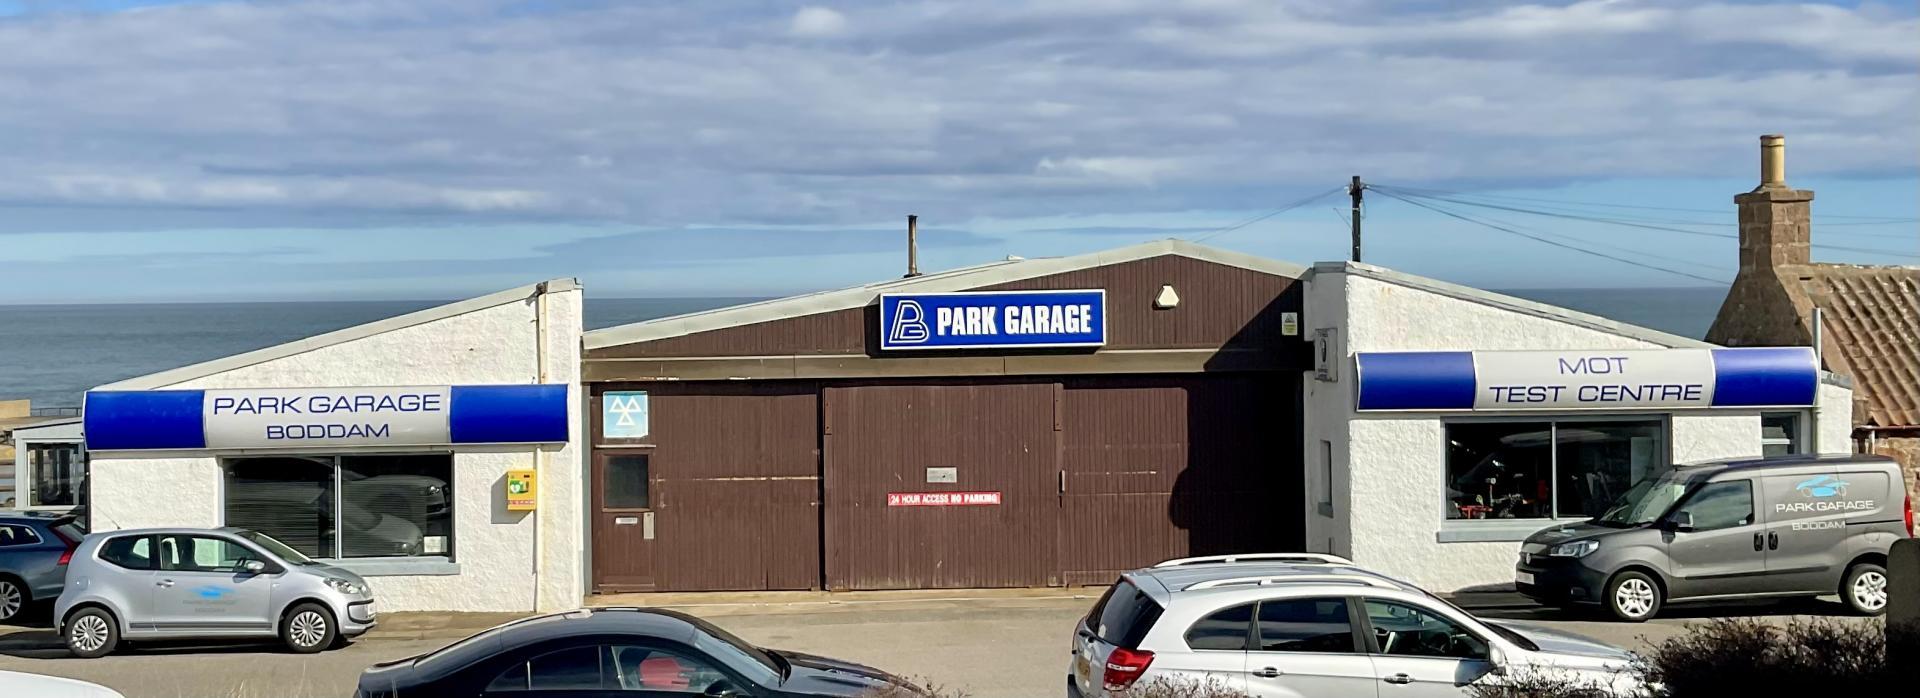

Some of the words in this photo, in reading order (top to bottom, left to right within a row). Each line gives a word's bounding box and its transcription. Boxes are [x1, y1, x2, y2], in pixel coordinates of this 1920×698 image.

[937, 306, 998, 336] PARK
[1004, 304, 1092, 335] GARAGE
[1558, 357, 1628, 375] MOT
[1489, 386, 1566, 403] TEST
[1578, 384, 1703, 402] CENTRE
[213, 396, 301, 415] PARK
[308, 394, 441, 413] GARAGE
[266, 423, 390, 440] BODDAM
[891, 494, 900, 504] 24
[902, 494, 920, 503] HOUR
[922, 494, 949, 503] ACCESS
[950, 494, 962, 503] NO
[963, 493, 997, 503] PARKING
[1775, 502, 1815, 513] PARK
[1816, 500, 1875, 511] GARAGE
[1791, 521, 1846, 531] BODDAM
